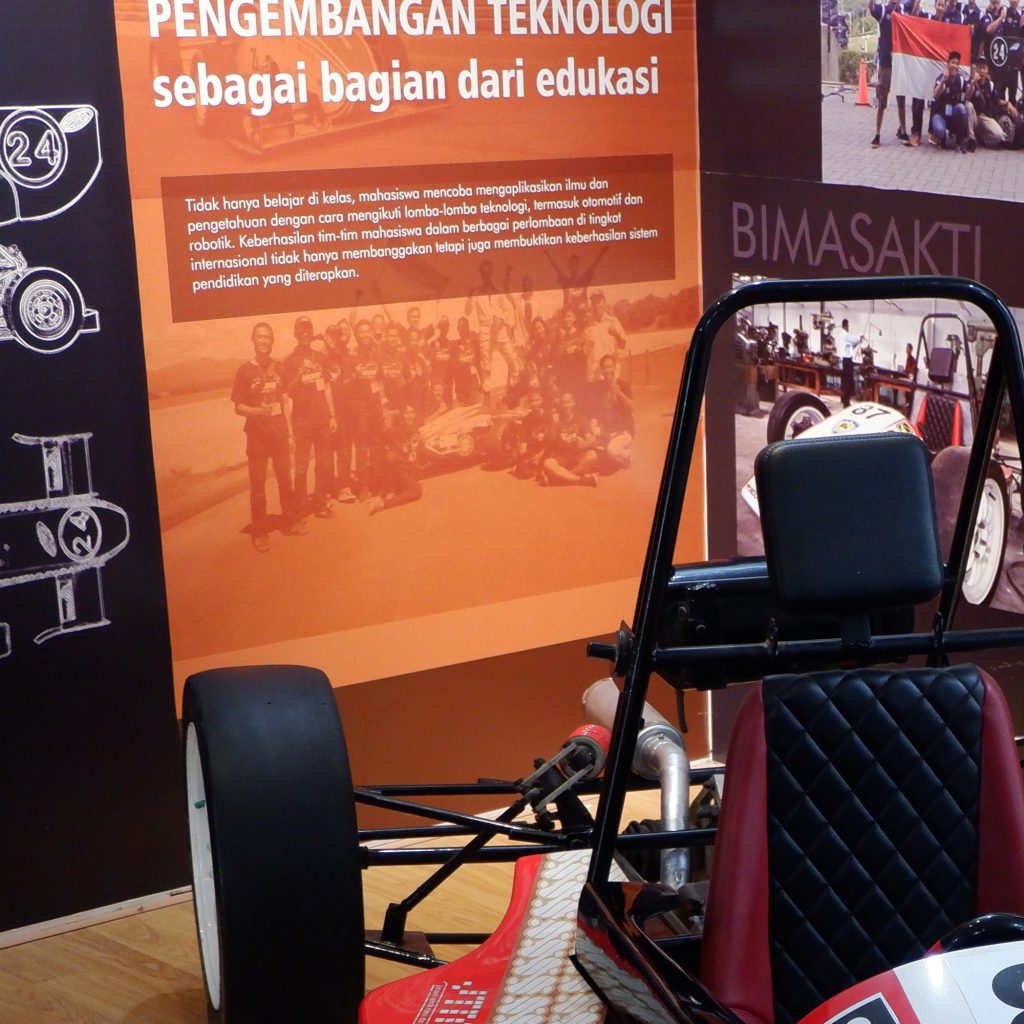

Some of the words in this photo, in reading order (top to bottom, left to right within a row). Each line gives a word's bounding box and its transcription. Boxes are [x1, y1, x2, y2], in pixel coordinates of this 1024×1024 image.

[148, 0, 474, 38] PENGEMBANGAN
[487, 0, 673, 35] TEKNOLOGI
[992, 39, 1006, 62] 24
[152, 62, 308, 117] sebagai
[320, 59, 447, 114] bagian
[457, 57, 526, 100] dari
[535, 55, 660, 98] edukasi
[6, 128, 61, 167] 24
[184, 196, 220, 213] Tidak
[223, 194, 260, 212] hanya
[263, 192, 305, 211] belajar
[308, 191, 320, 206] di
[322, 189, 356, 206] kelas,
[358, 187, 420, 203] mahasiswa
[423, 183, 473, 199] mencoba
[475, 180, 563, 198] mengaplikasikan
[565, 178, 587, 192] ilmu
[589, 177, 609, 191] dan
[187, 214, 267, 236] pengetahuan
[270, 211, 315, 230] dengan
[318, 211, 344, 225] cara
[347, 206, 402, 224] mengikuti
[404, 200, 477, 219] lomba-lomba
[479, 198, 531, 215] teknologi,
[533, 196, 580, 212] termasuk
[581, 193, 623, 209] otomotif
[624, 192, 643, 206] dan
[189, 235, 236, 252] robotik.
[239, 231, 315, 249] Keberhasilan
[318, 228, 358, 243] tim-tim
[361, 225, 423, 241] mahasiswa
[425, 219, 460, 236] dalam
[462, 217, 510, 235] berbagai
[512, 215, 574, 232] perlombaan
[576, 212, 587, 226] di
[589, 211, 622, 227] tingkat
[190, 253, 268, 272] internasional
[271, 250, 301, 266] tidak
[303, 247, 339, 265] hanya
[342, 241, 433, 261] membanggakan
[435, 239, 465, 255] tetapi
[467, 237, 491, 254] juga
[493, 233, 563, 250] membuktikan
[564, 228, 628, 245] keberhasilan
[628, 226, 659, 241] sistem
[731, 201, 982, 281] BIMASAKTI
[192, 274, 260, 294] pendidikan
[262, 271, 292, 289] yang
[294, 265, 361, 284] diterapkan.
[851, 404, 892, 420] 87
